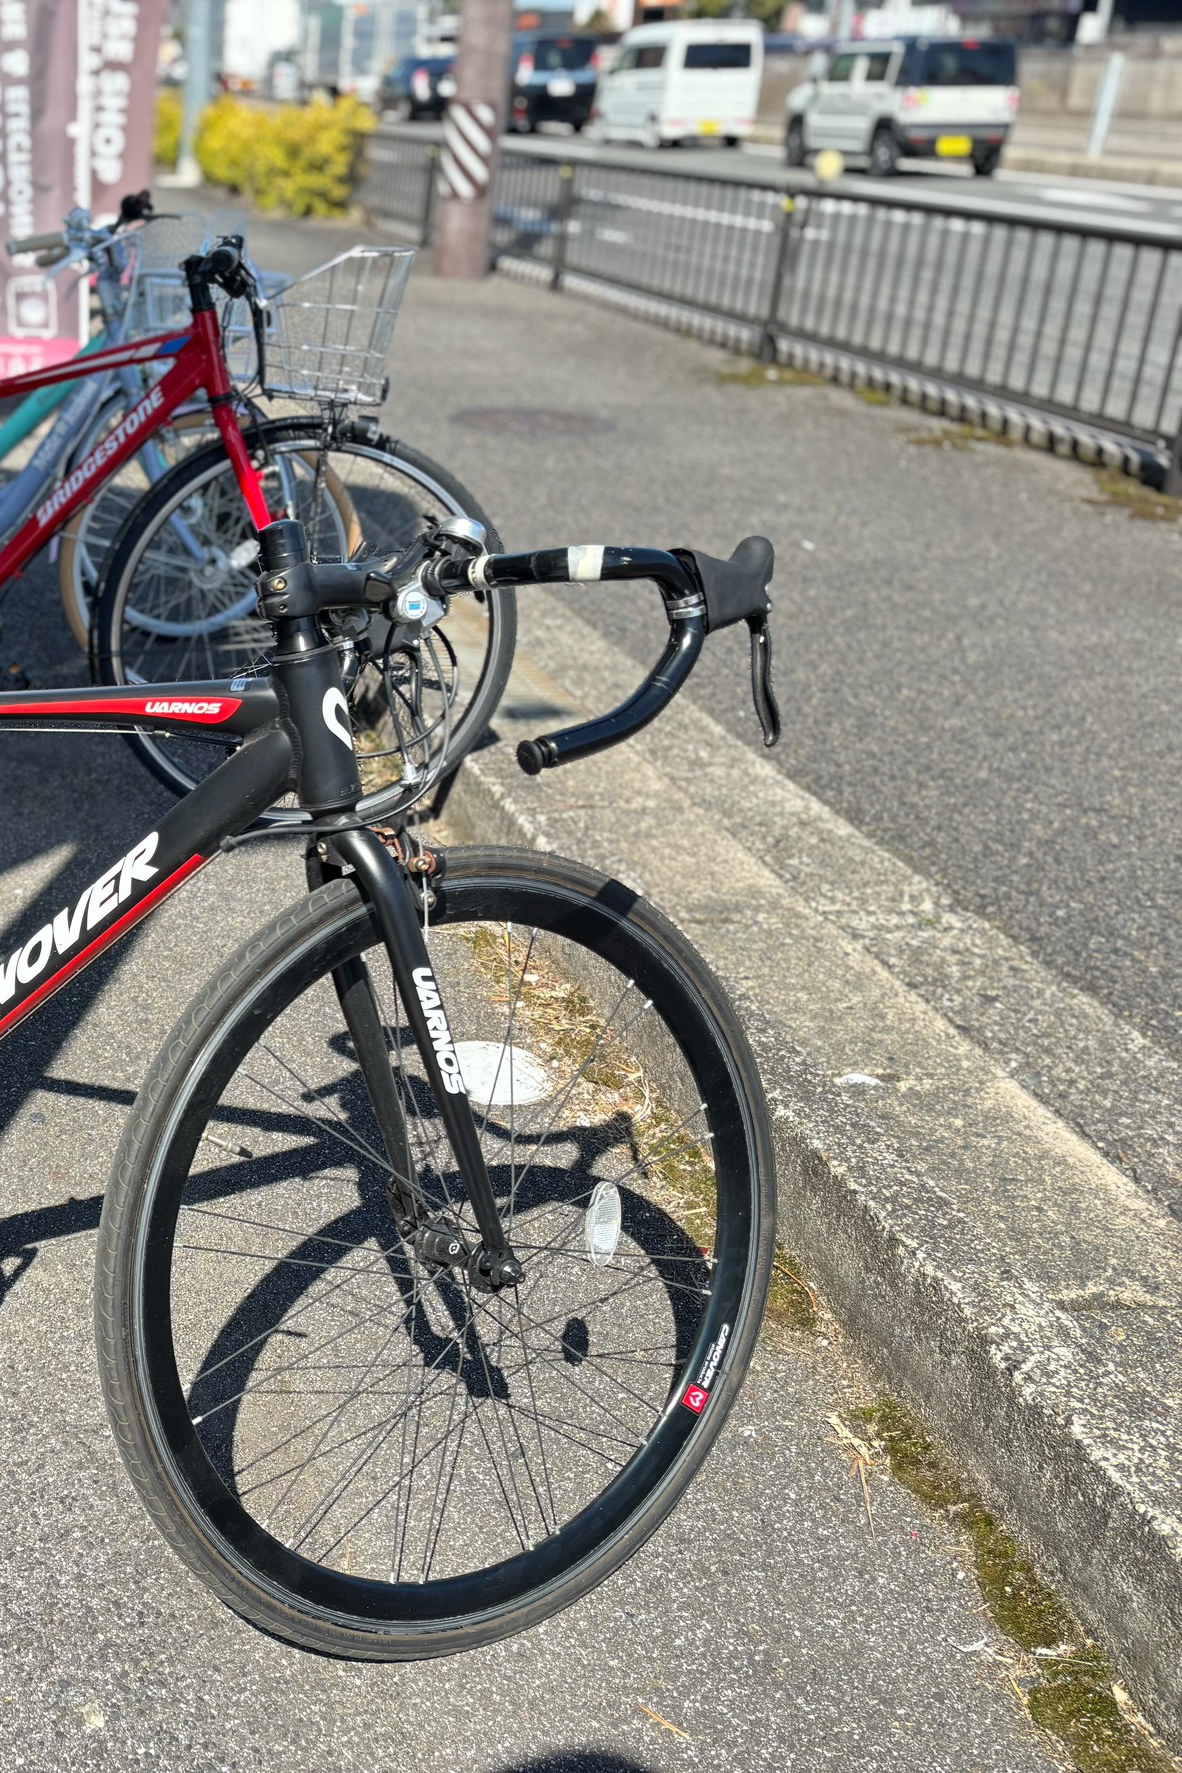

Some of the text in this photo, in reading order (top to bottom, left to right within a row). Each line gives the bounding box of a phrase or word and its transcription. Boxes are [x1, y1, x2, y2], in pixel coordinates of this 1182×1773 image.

[92, 69, 131, 184] SHOP
[37, 386, 165, 527] BRIDGESTONE
[144, 701, 222, 716] UARNOS
[411, 966, 466, 1095] UARNOS
[702, 1324, 729, 1389] CANOVER
